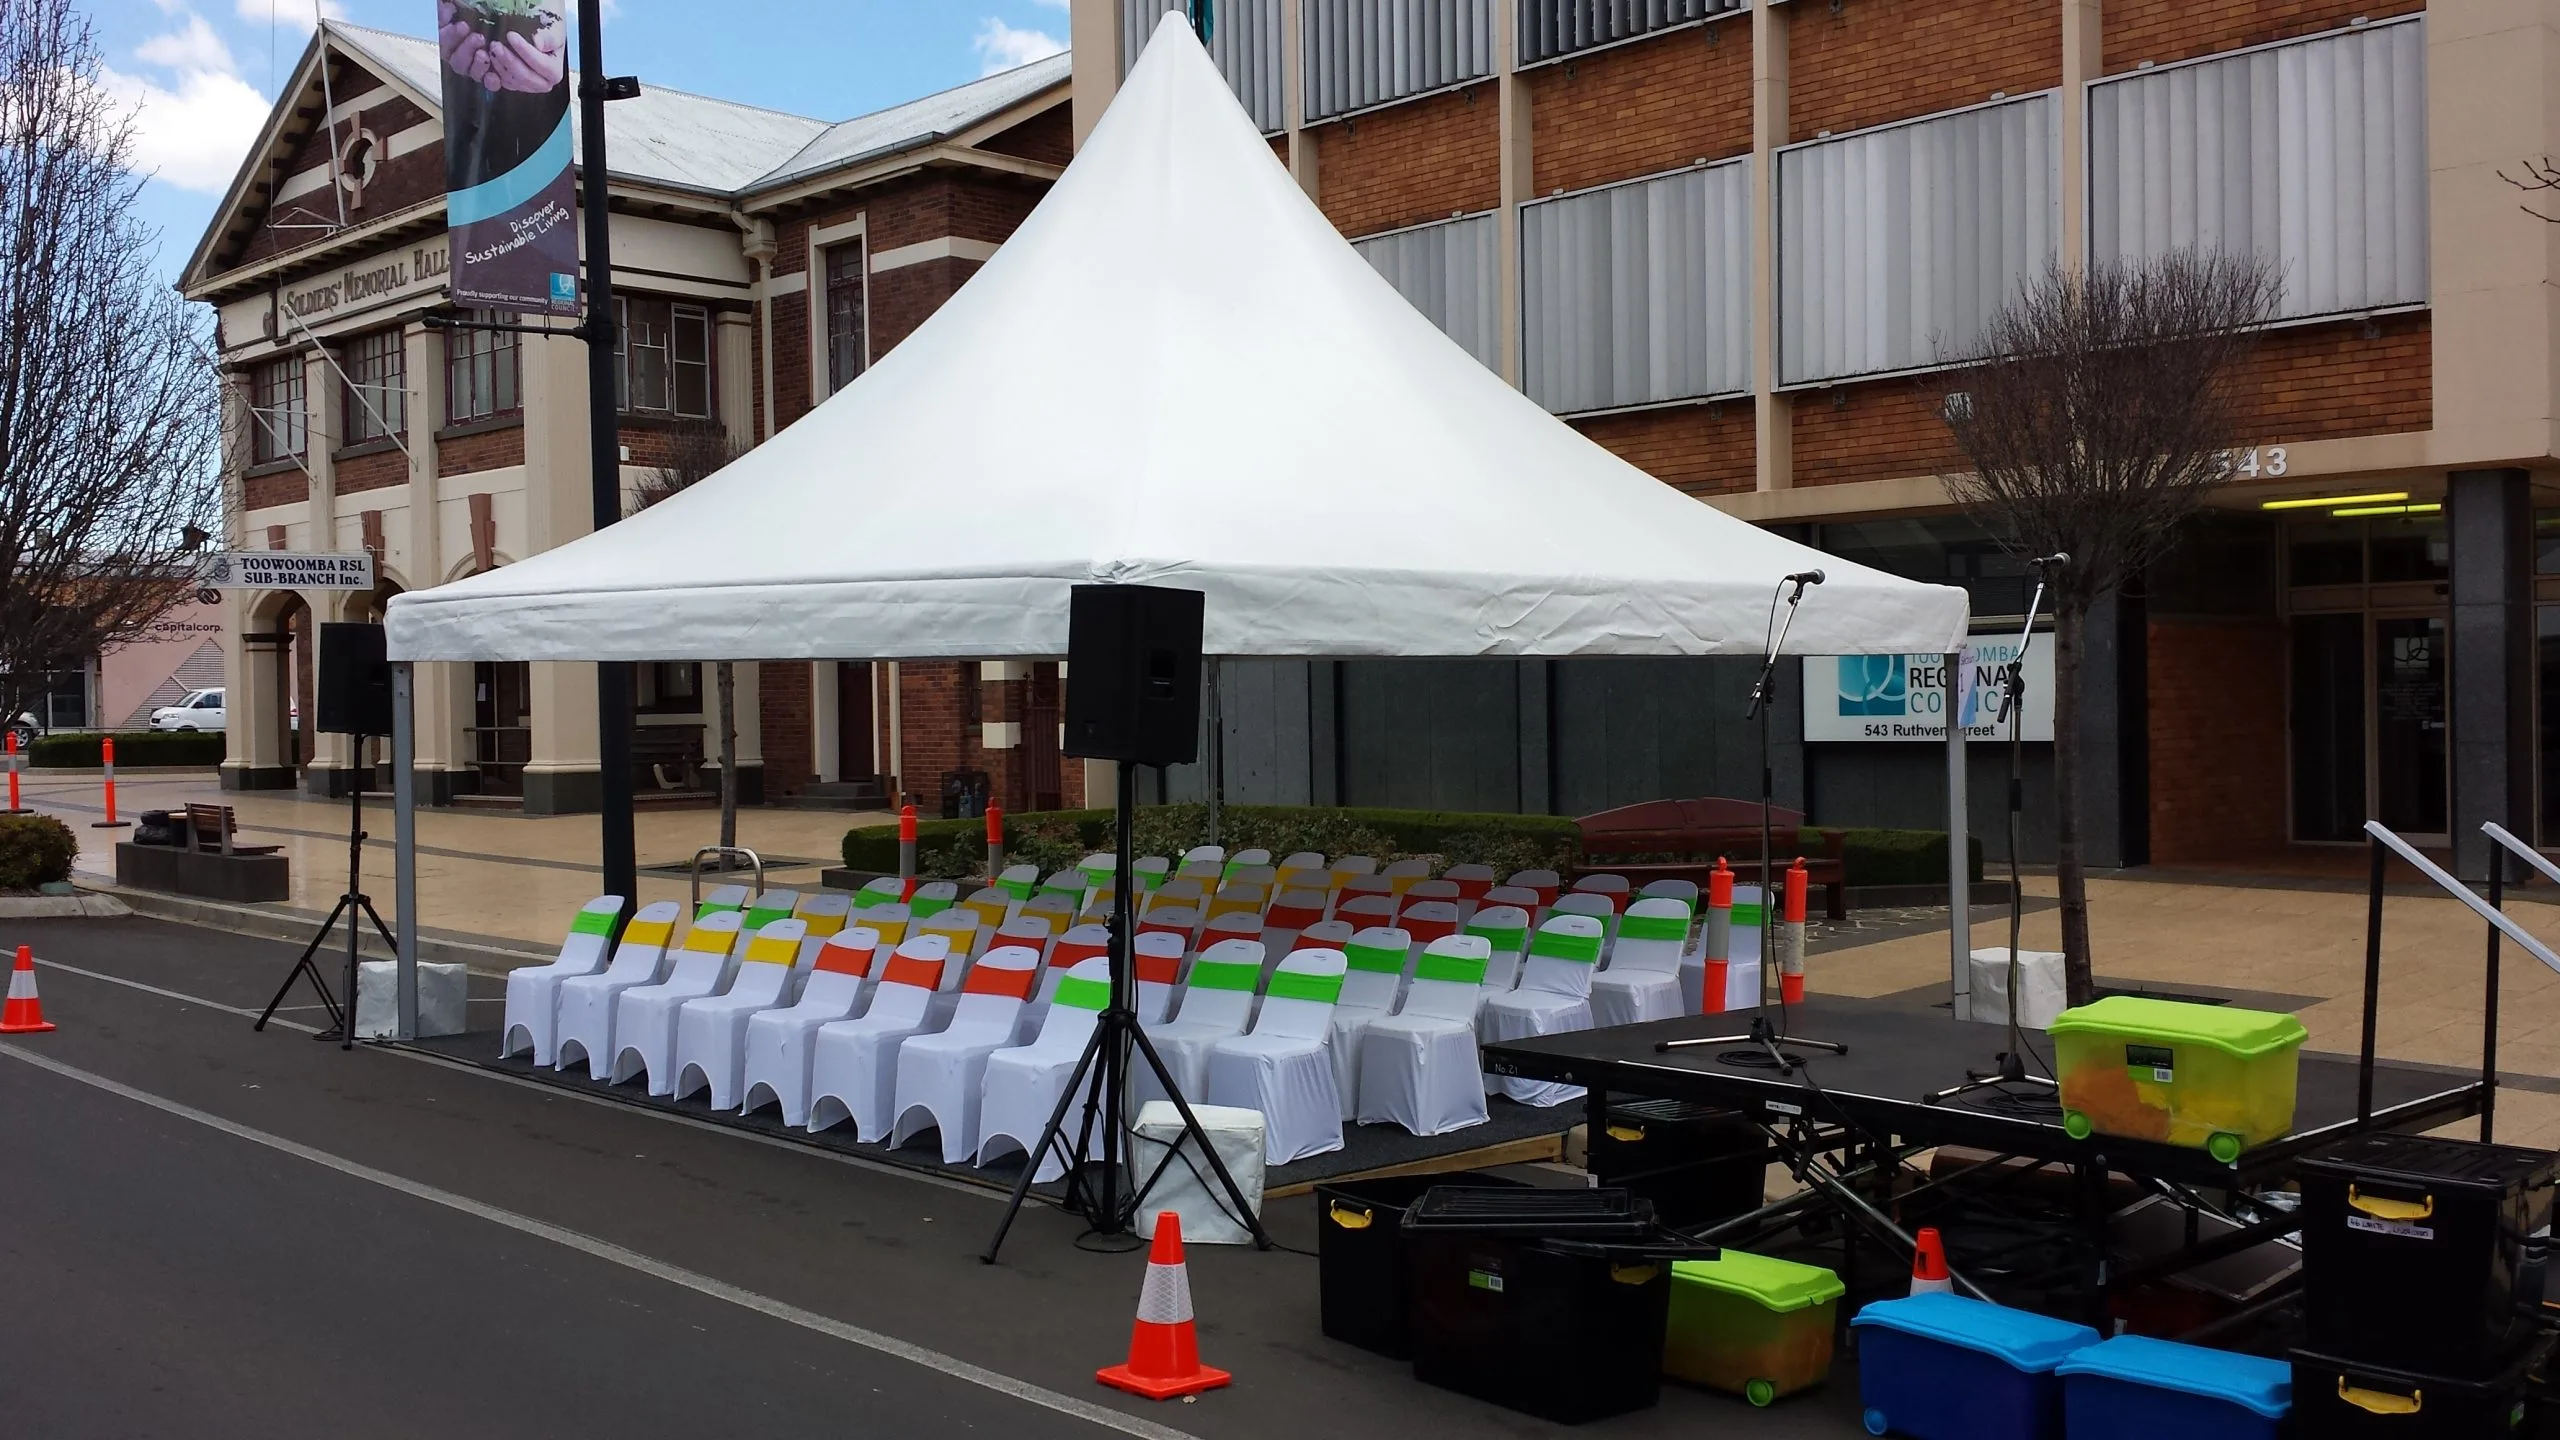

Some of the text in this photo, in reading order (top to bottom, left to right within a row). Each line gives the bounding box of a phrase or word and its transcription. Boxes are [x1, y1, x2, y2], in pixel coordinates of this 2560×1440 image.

[510, 200, 555, 233] Discover
[465, 206, 569, 264] Sustainable Living
[344, 262, 408, 303] MEMORIAL
[456, 288, 478, 299] Proudly
[479, 290, 508, 302] supporting
[519, 295, 549, 305] community
[241, 557, 366, 572] TOOWOOMBA RSL
[244, 572, 363, 585] SUB-BRANCH Inc.
[1864, 725, 1889, 736] 543
